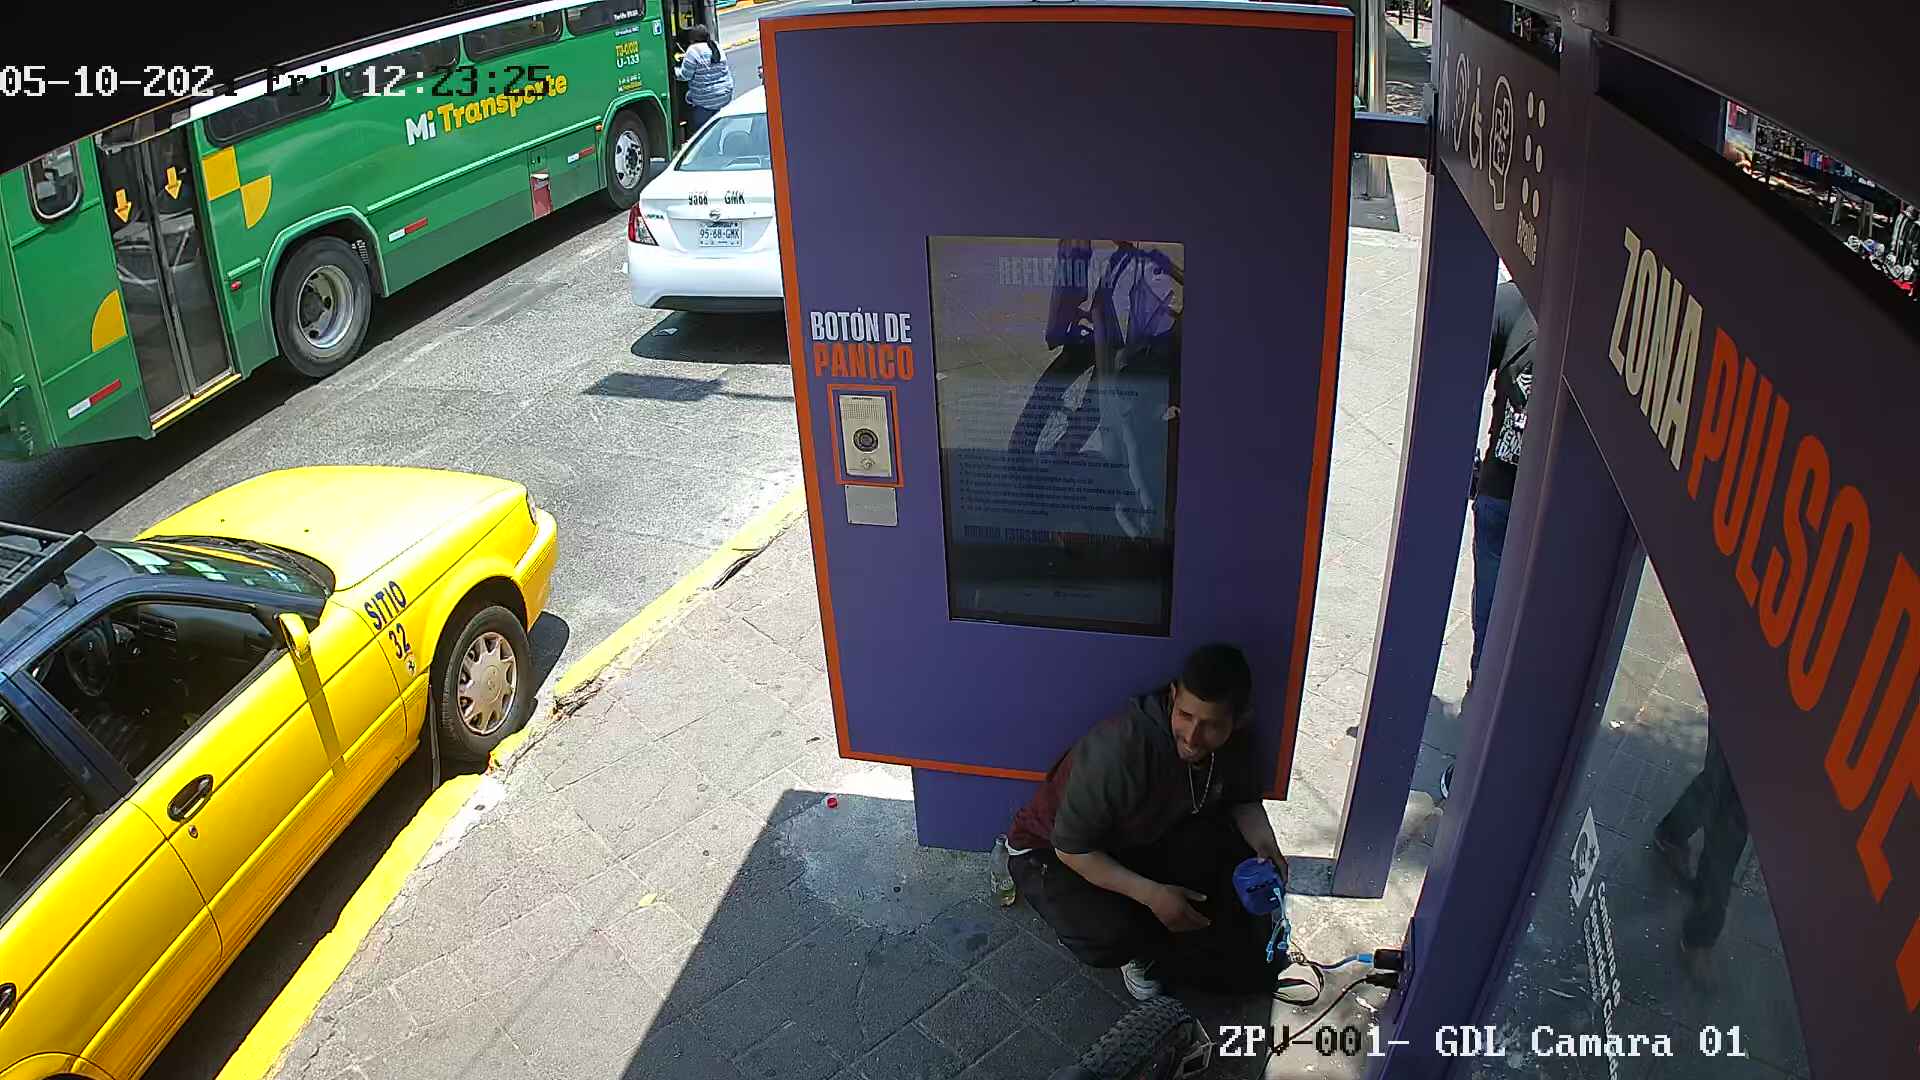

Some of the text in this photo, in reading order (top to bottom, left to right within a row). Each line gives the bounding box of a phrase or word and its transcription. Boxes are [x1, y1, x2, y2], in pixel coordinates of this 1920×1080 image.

[616, 55, 640, 69] U-133
[405, 74, 567, 146] Mi Transporte
[810, 307, 912, 343] BOTÓN DE
[1608, 226, 1703, 472] ZONA
[1687, 326, 1872, 712] PULSO
[364, 580, 407, 631] SITIO
[388, 622, 411, 660] 32
